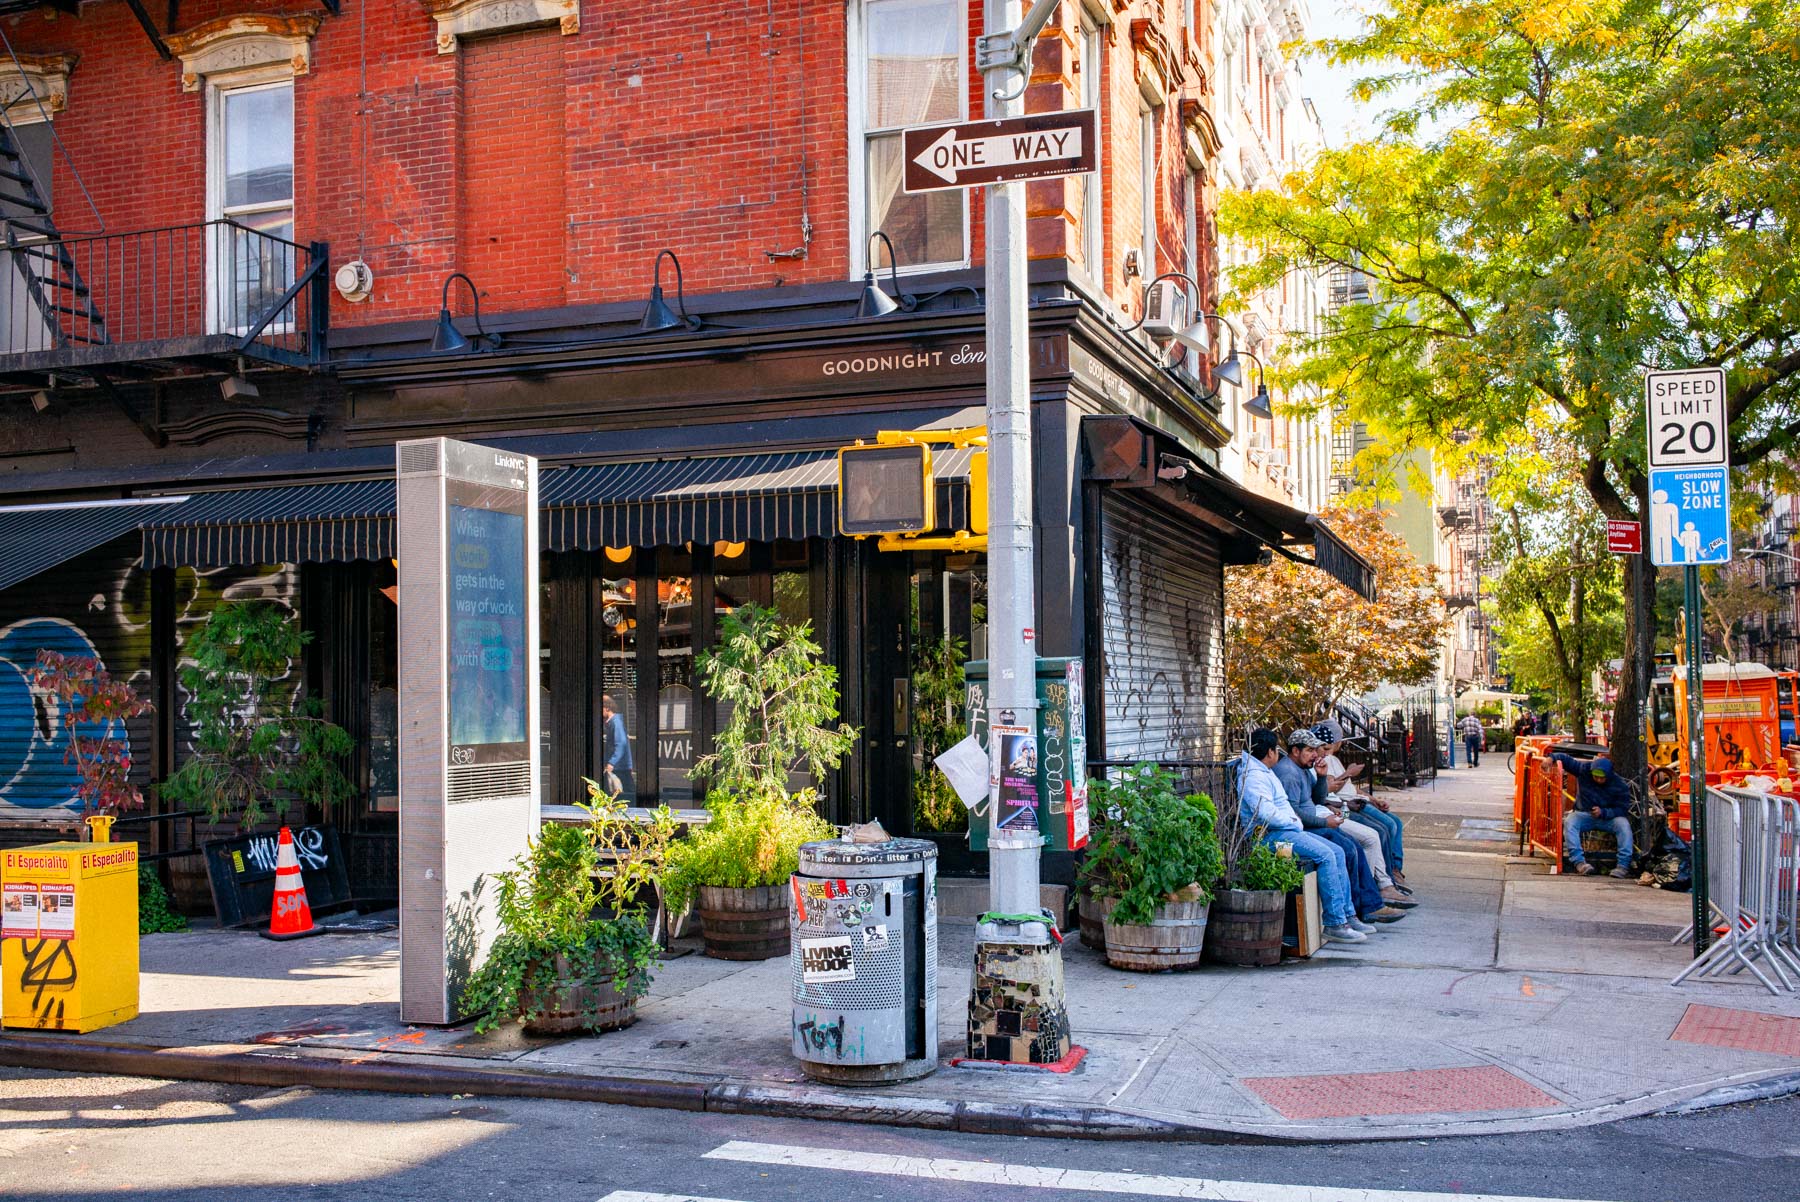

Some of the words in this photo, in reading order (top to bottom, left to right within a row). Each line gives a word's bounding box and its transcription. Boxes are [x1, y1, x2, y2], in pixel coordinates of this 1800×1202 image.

[933, 142, 985, 169] ONE
[1013, 132, 1069, 160] WAY
[822, 351, 943, 375] GOODNIGHT
[1656, 380, 1716, 397] SPEED
[1661, 399, 1712, 416] LIMIT
[1660, 421, 1716, 455] 20
[494, 453, 525, 470] LinkNYC
[1674, 471, 1723, 481] NEIGHBORHOOD
[1682, 480, 1721, 495] SLOW
[1682, 495, 1722, 510] ZONE
[455, 519, 486, 538] When
[1609, 531, 1626, 539] Anytime
[1616, 524, 1636, 532] STANDING
[455, 573, 477, 591] gets
[478, 574, 488, 589] in
[489, 576, 505, 590] the
[455, 599, 477, 616] way
[478, 598, 489, 613] of
[456, 650, 479, 667] with
[7, 854, 16, 867] El
[18, 854, 68, 870] Especialito
[82, 855, 90, 869] El
[92, 849, 136, 869] Especialito
[885, 852, 908, 862] litter
[802, 944, 852, 960] LIVING
[803, 957, 853, 973] PROOF
